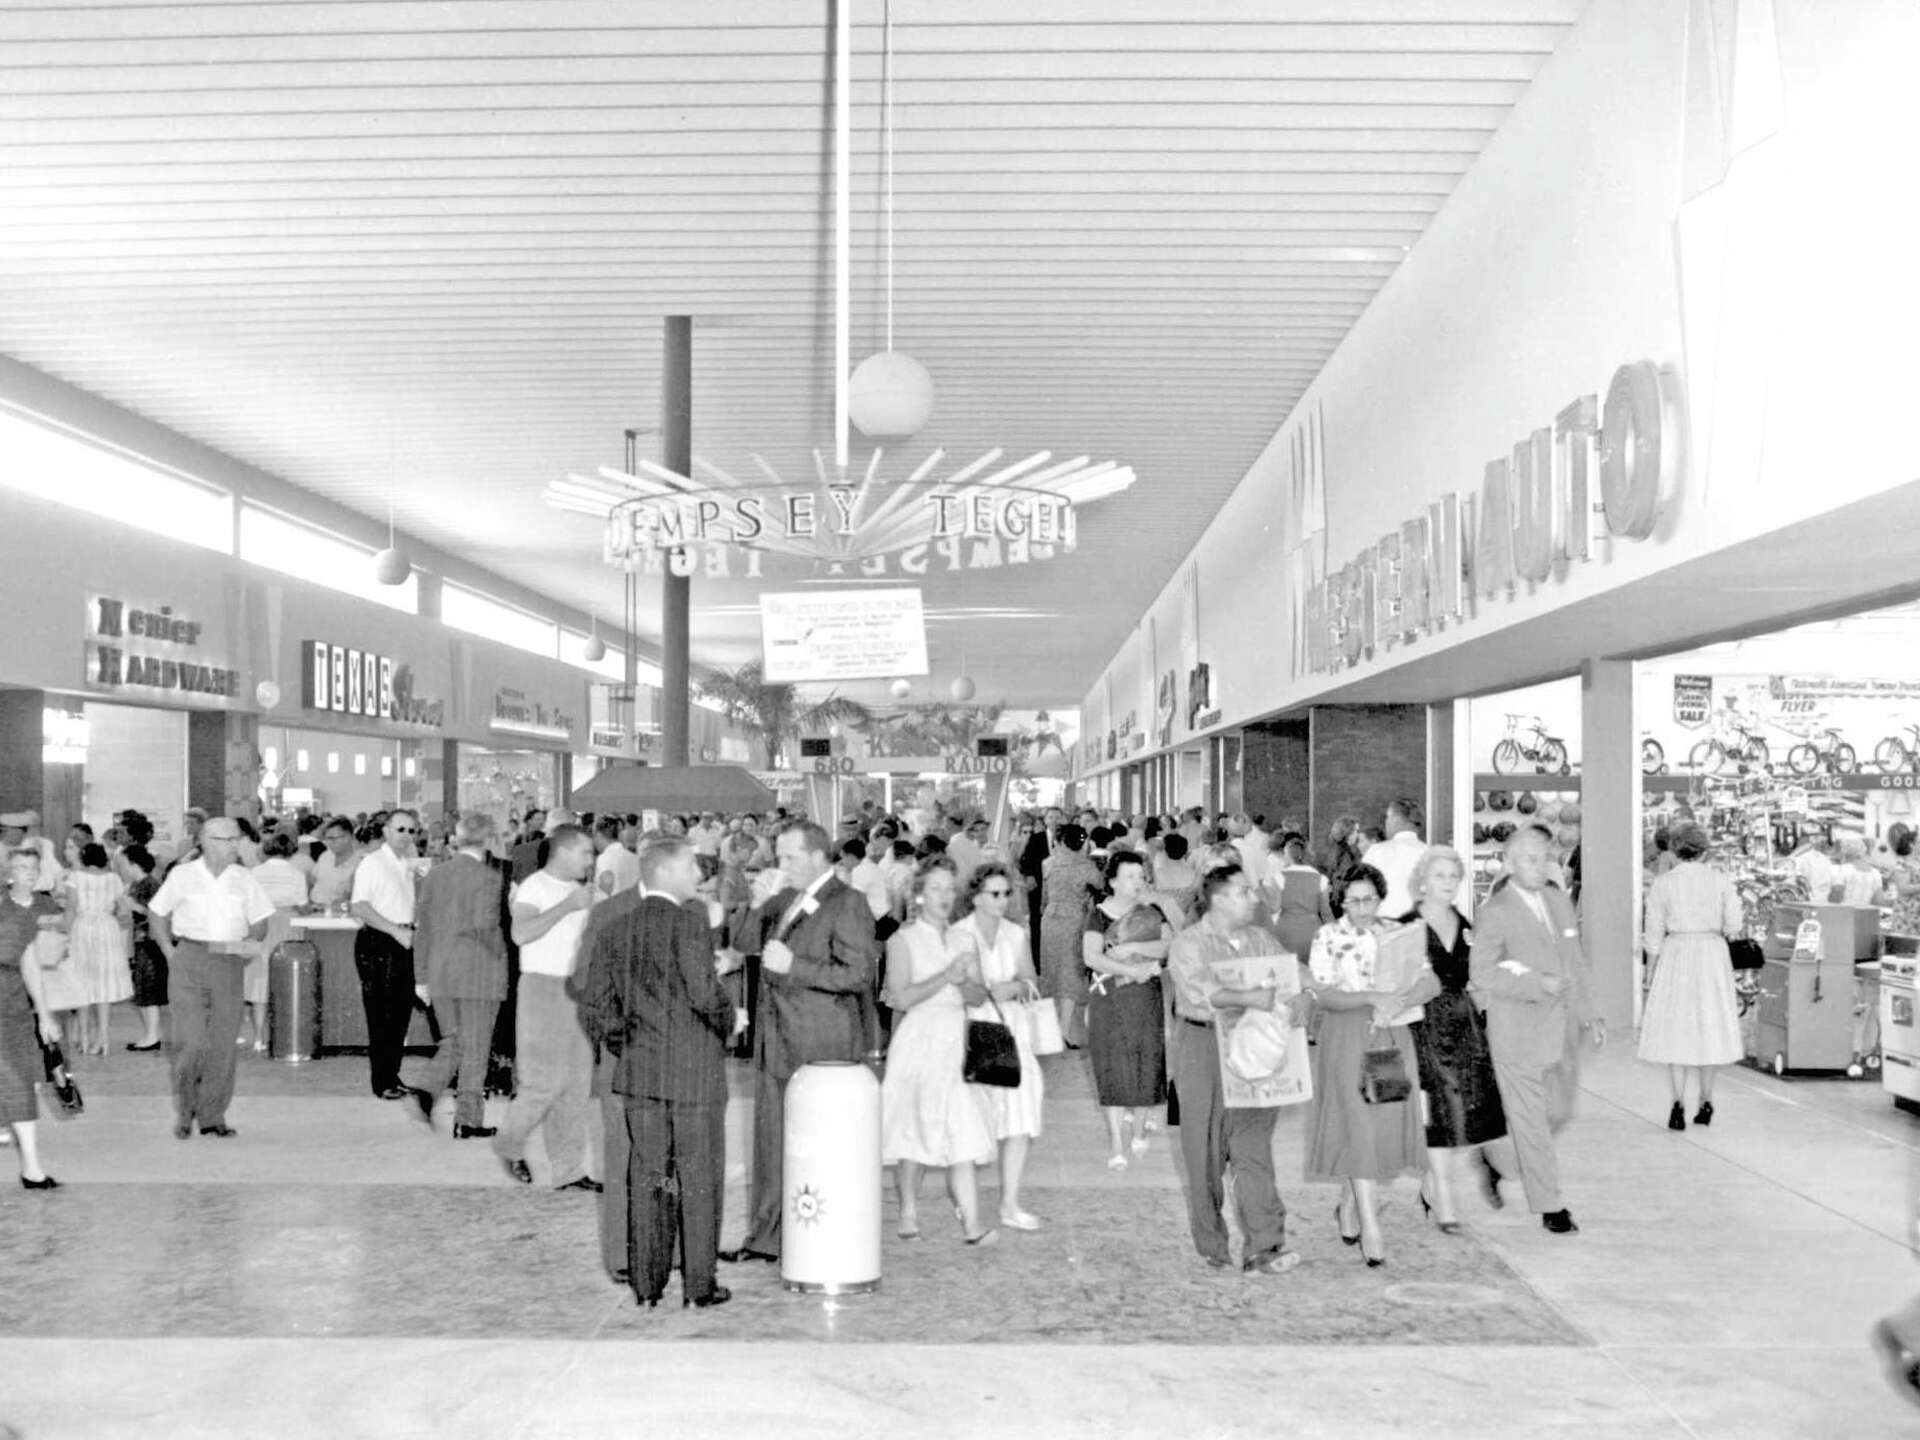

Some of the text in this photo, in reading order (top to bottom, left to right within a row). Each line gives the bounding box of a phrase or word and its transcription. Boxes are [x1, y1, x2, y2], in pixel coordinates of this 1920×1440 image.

[1475, 360, 1663, 600] AUTO
[98, 645, 240, 698] HARDWARE
[312, 643, 391, 717] TEXAS
[1679, 709, 1705, 722] SALE
[1780, 700, 1817, 713] FLYER
[815, 757, 1007, 774] 680 RADIO
